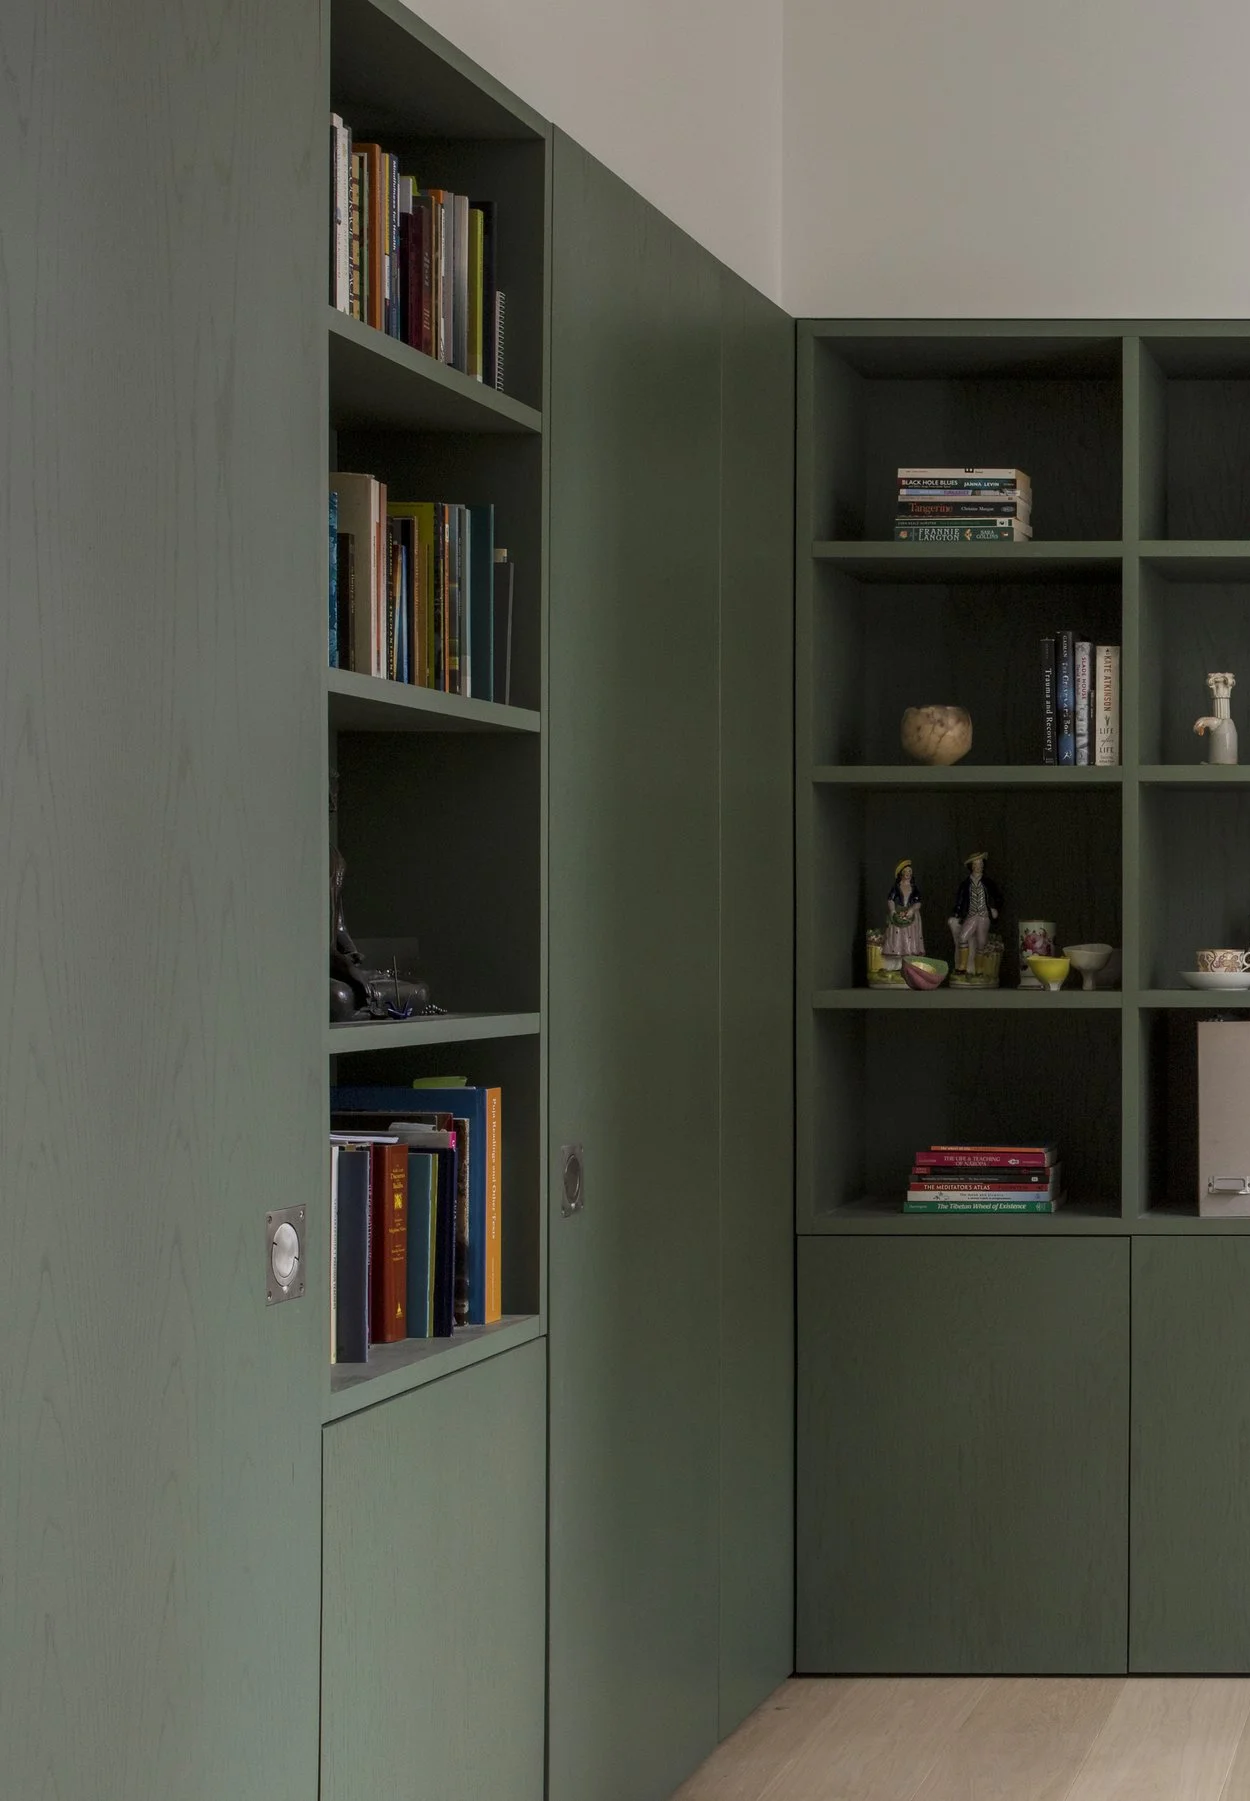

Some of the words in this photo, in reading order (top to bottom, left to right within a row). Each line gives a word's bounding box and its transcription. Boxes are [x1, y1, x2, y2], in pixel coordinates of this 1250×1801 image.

[1104, 655, 1112, 673] KATE
[1104, 675, 1112, 712] ATKINSON
[1045, 716, 1053, 752] Recovery
